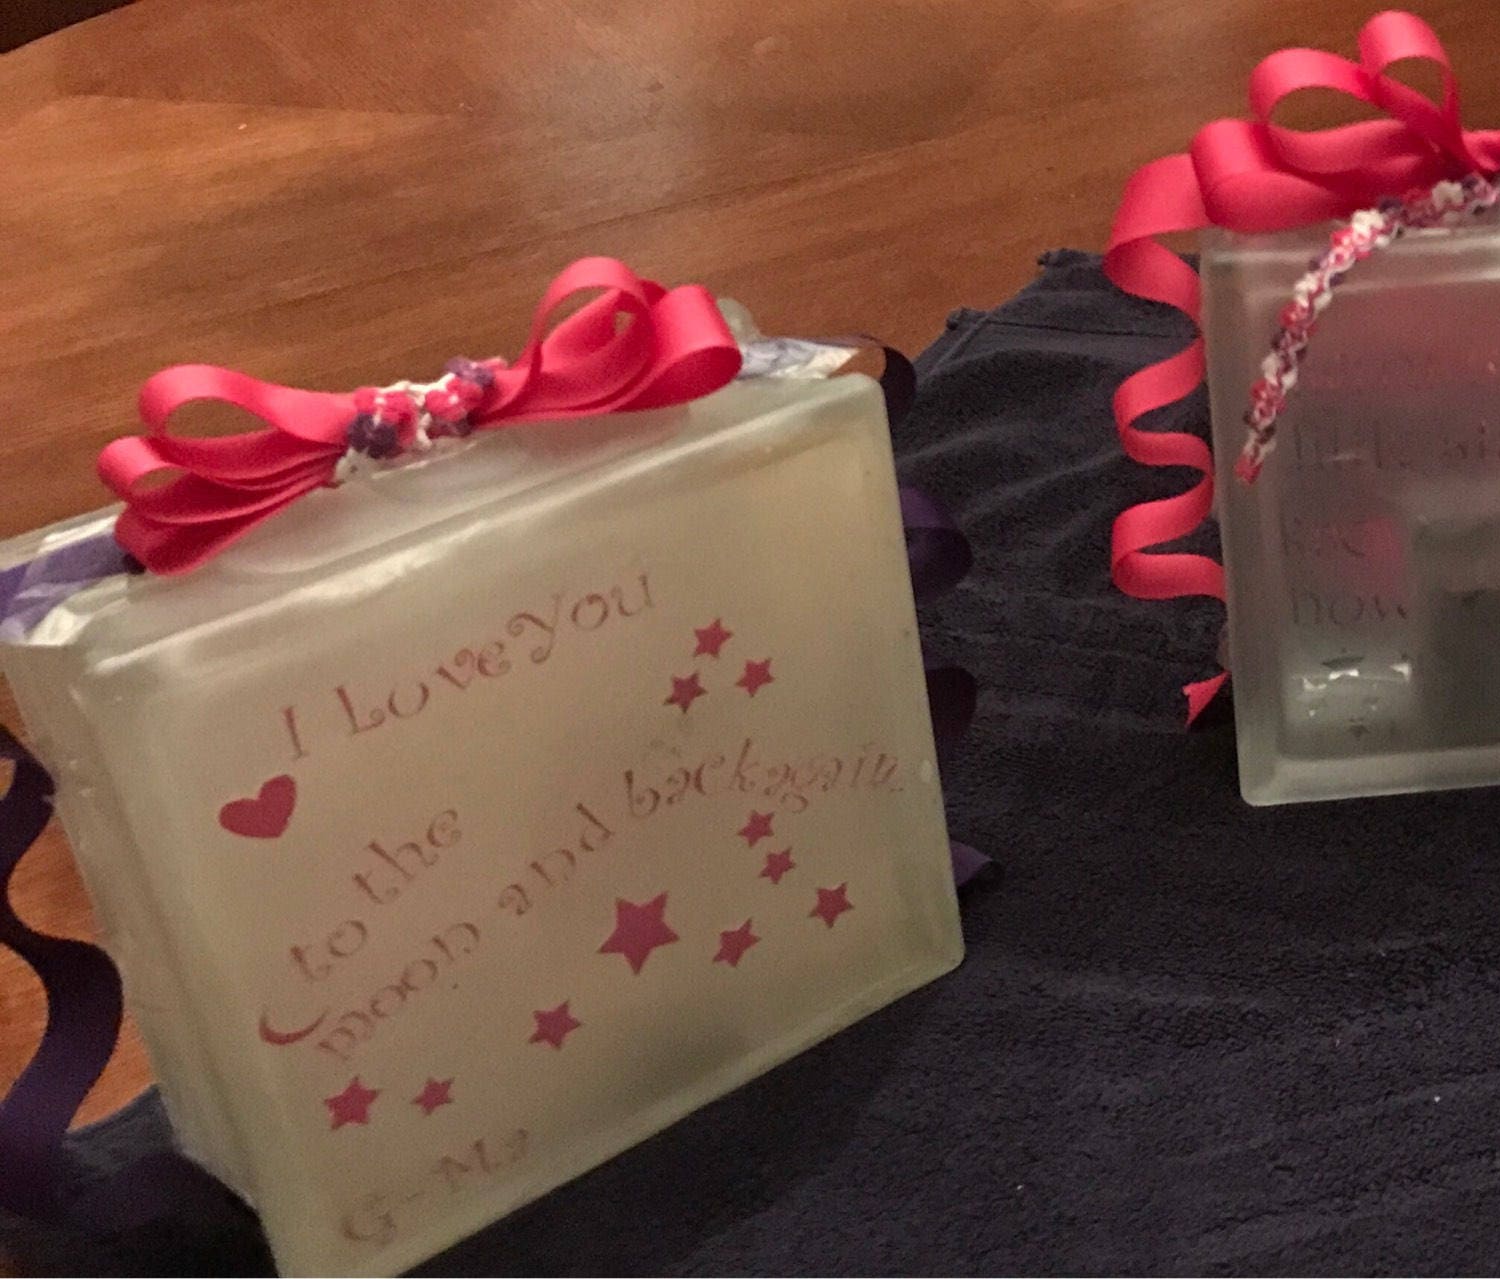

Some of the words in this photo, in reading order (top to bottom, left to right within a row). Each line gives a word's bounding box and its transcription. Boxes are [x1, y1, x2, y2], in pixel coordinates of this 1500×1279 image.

[280, 704, 311, 760] I
[335, 638, 512, 736] Love
[507, 573, 658, 664] You
[288, 917, 370, 984] to
[352, 807, 463, 906] the
[315, 919, 482, 1064] moon
[497, 801, 616, 918] and
[622, 738, 760, 820] back
